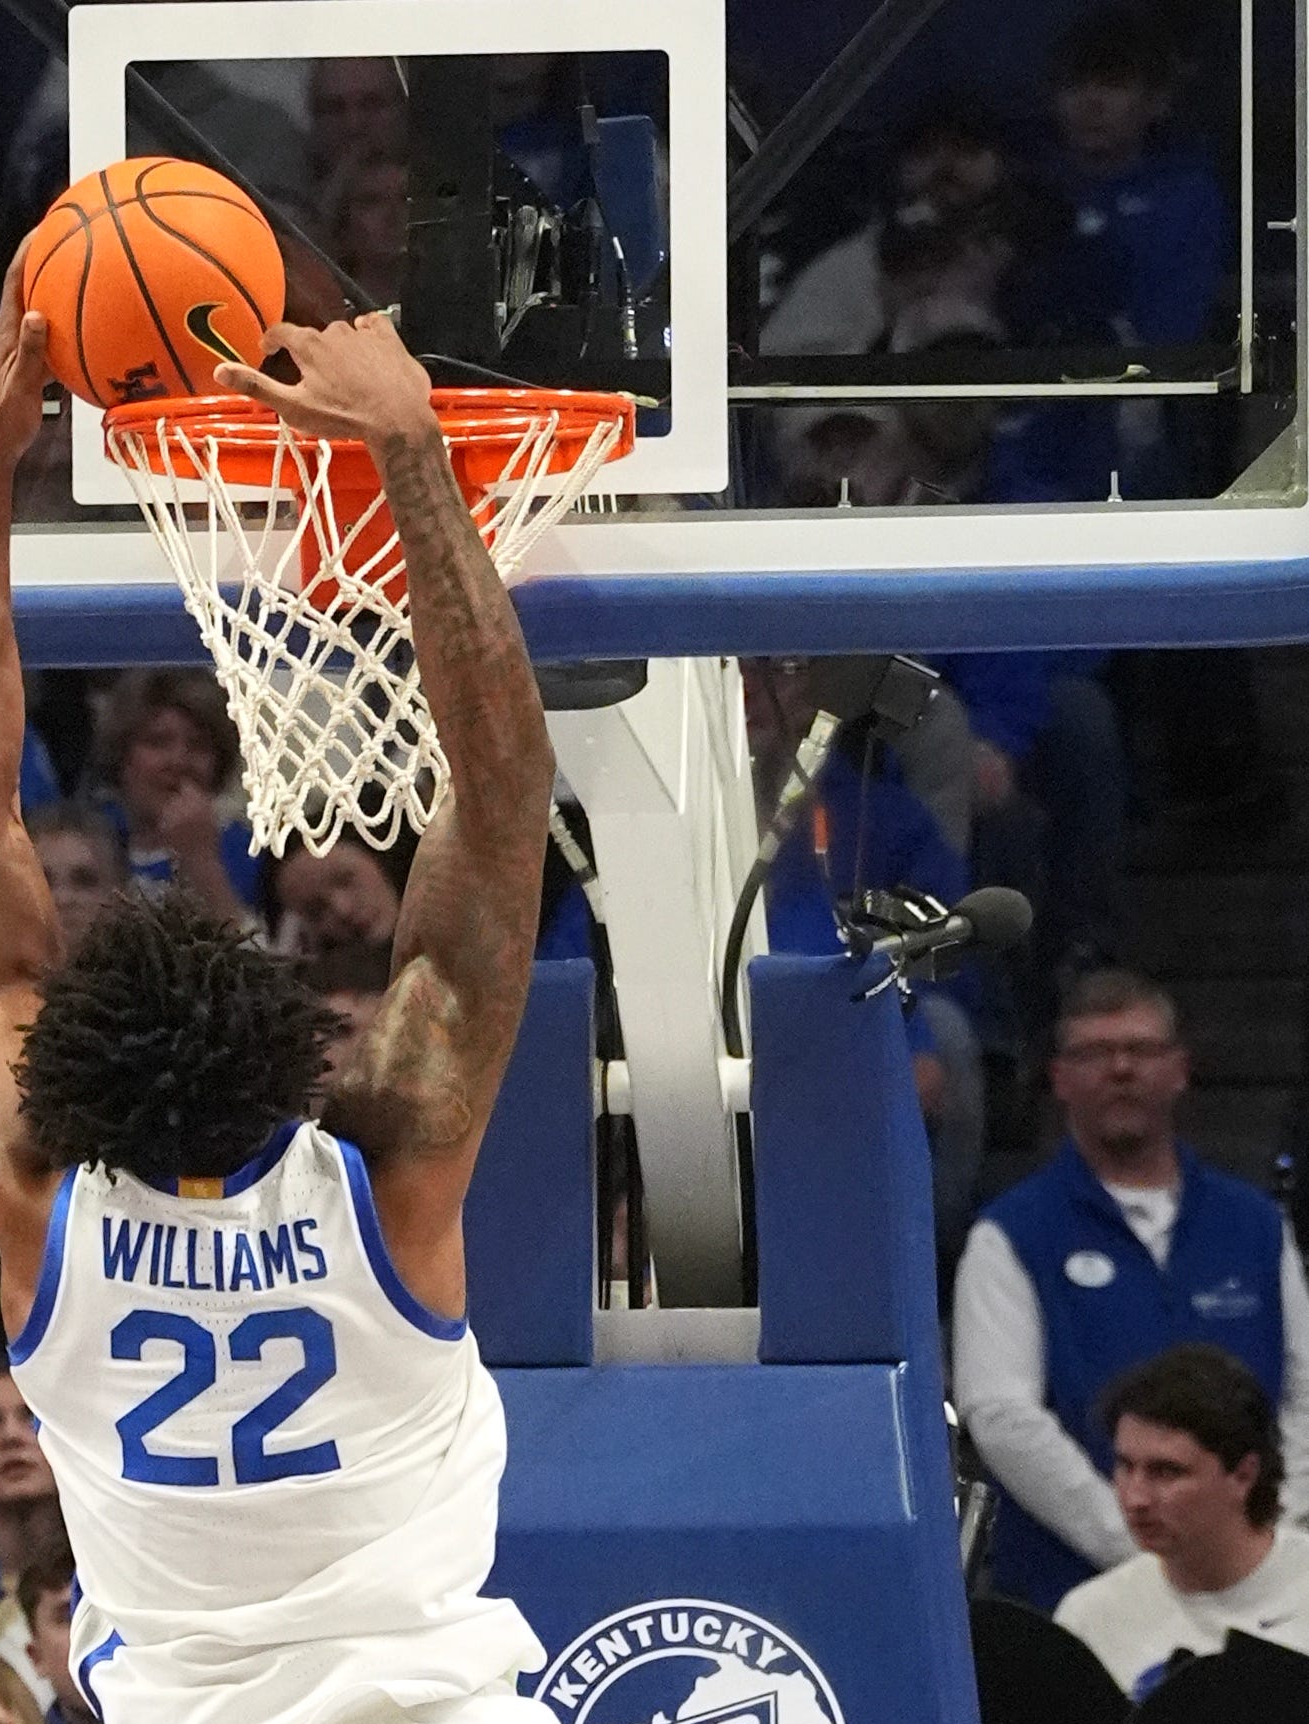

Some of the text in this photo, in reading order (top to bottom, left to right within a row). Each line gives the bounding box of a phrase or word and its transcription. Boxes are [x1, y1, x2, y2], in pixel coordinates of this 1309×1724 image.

[101, 1216, 329, 1292] WILLIAMS
[109, 1305, 342, 1487] 22
[549, 1610, 788, 1710] KENTUCKY
